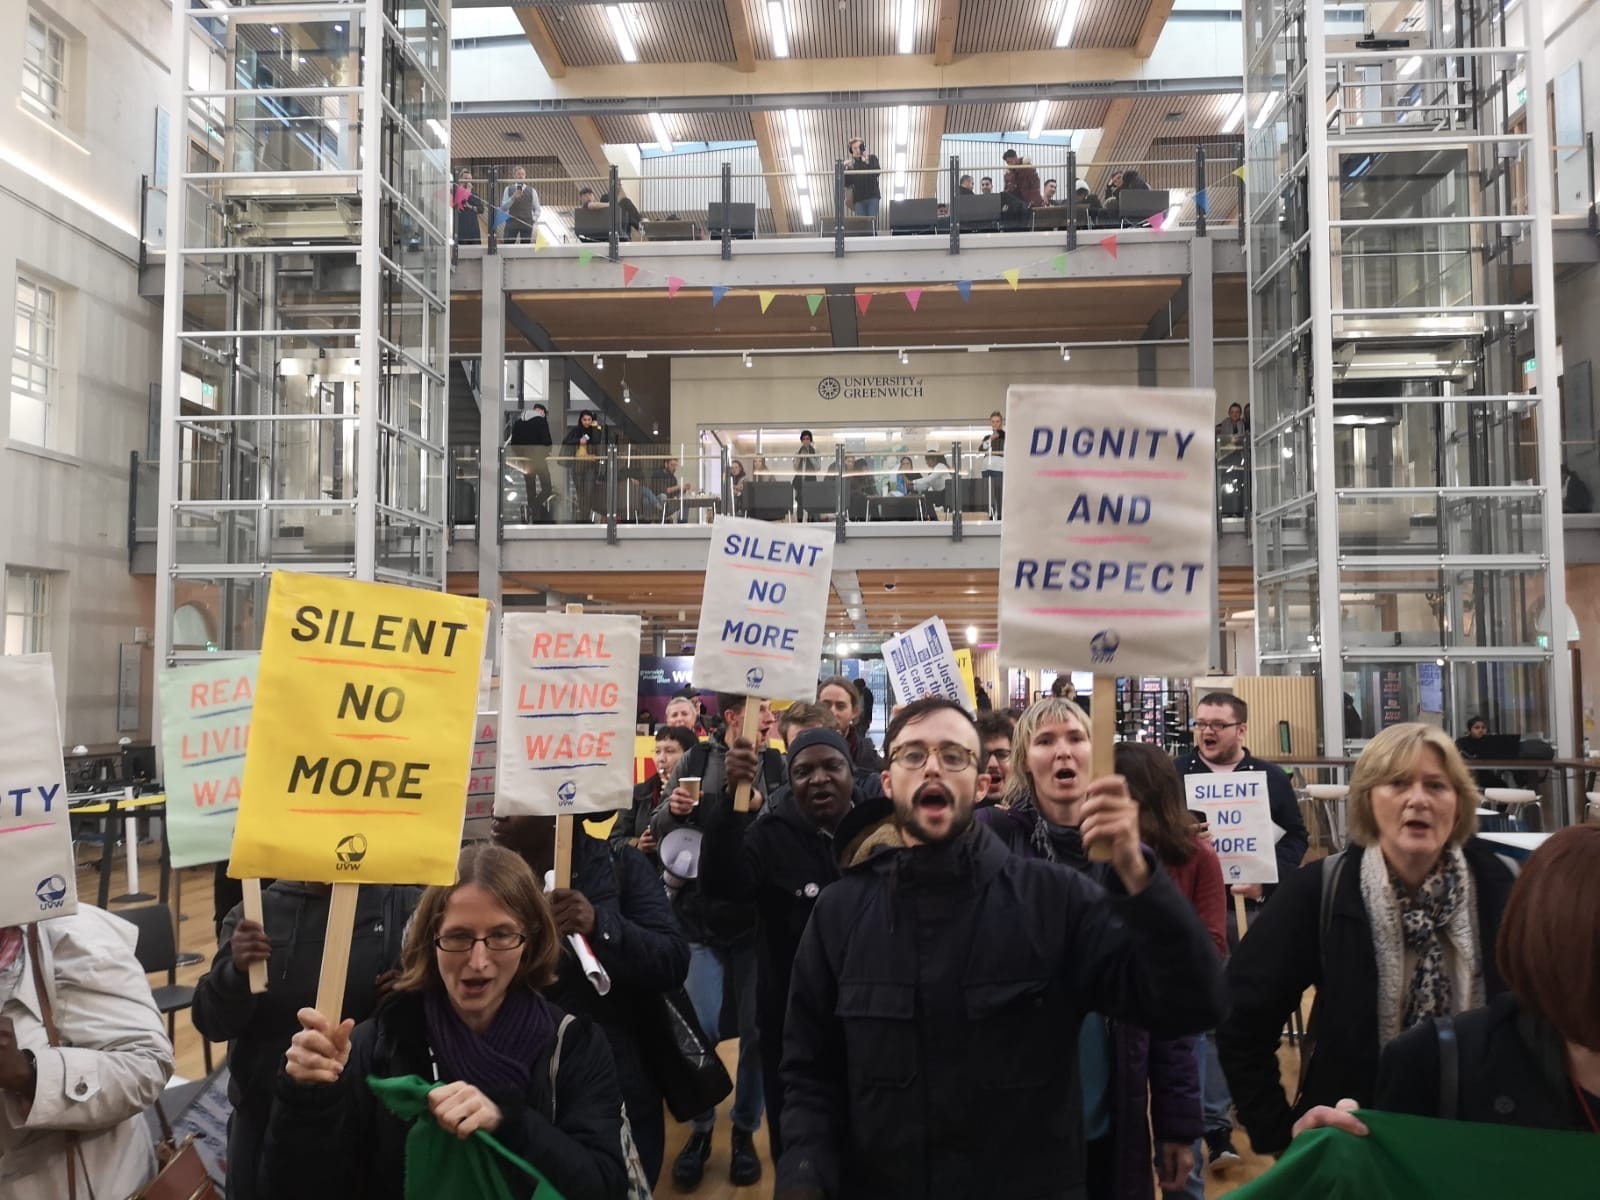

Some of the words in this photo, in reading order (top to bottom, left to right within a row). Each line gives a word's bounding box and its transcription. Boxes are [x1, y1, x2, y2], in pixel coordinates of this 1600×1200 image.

[844, 376, 915, 387] UNIVERSITY
[844, 387, 923, 399] GREENWICH
[1030, 426, 1195, 461] DIGNITY
[1067, 492, 1151, 526] AND
[723, 533, 824, 568] SILENT
[748, 579, 787, 604] NO
[1014, 559, 1205, 595] RESPECT
[290, 605, 468, 658] SILENT
[531, 632, 613, 660] REAL
[721, 619, 799, 652] MORE
[336, 682, 405, 723] NO
[517, 681, 620, 711] LIVING
[524, 731, 616, 762] WAGE
[287, 754, 431, 800] MORE
[1194, 783, 1259, 800] SILENT
[0, 783, 61, 817] TY
[1218, 810, 1242, 825] NO
[336, 863, 361, 871] UVW
[40, 901, 64, 911] UVW
